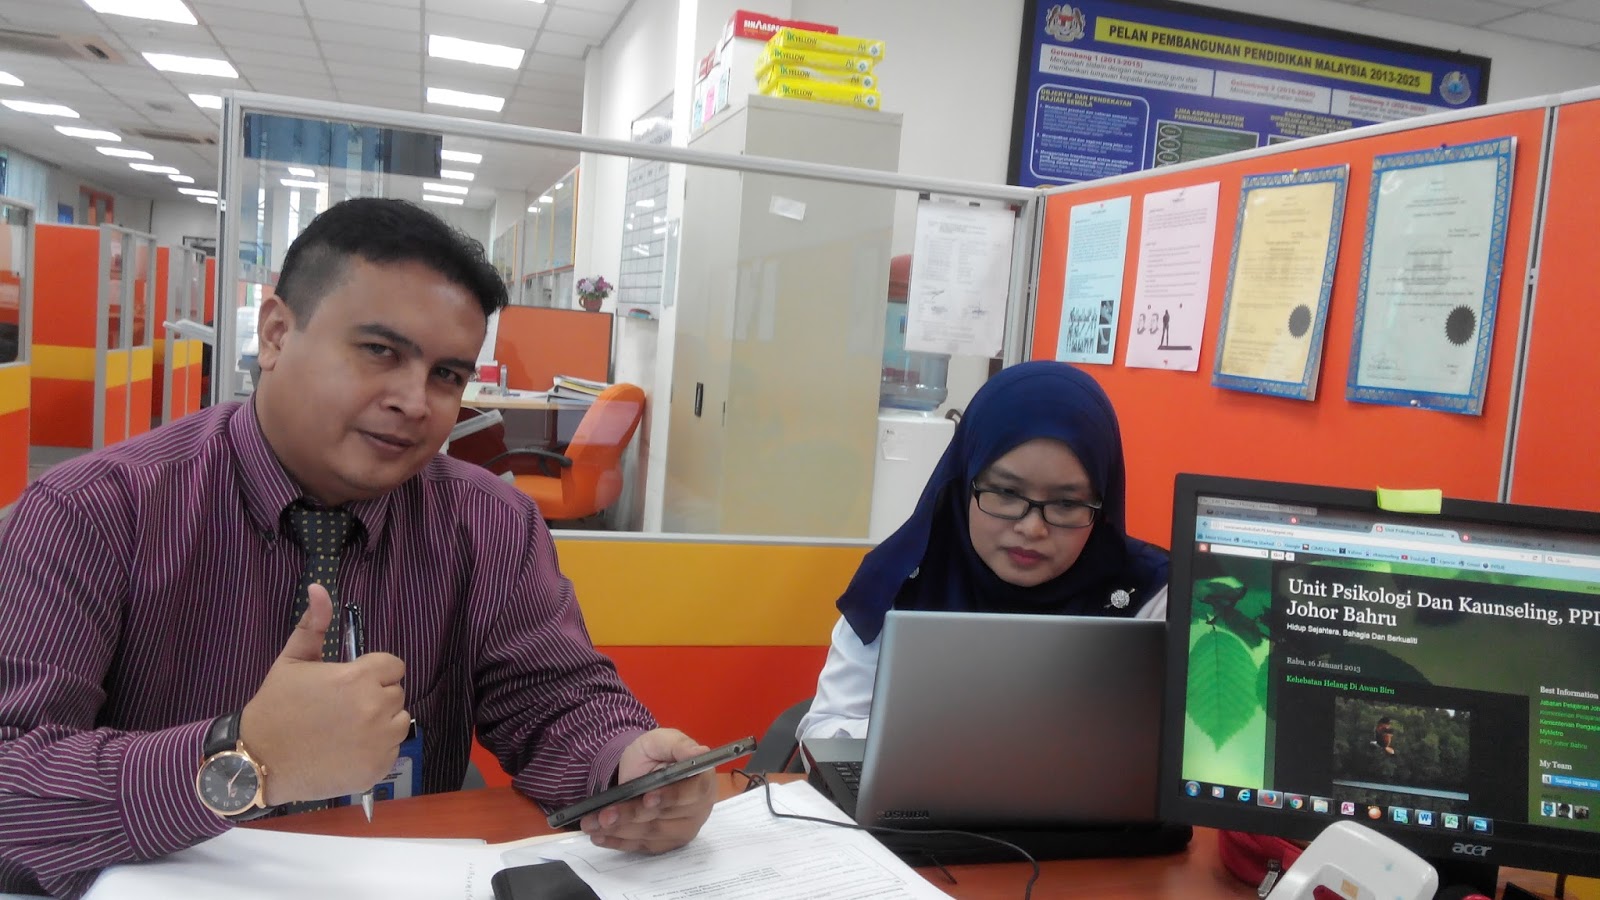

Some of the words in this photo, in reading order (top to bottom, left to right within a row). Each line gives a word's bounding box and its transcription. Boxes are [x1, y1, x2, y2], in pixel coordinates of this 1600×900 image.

[796, 36, 817, 45] YELLOW
[784, 52, 805, 62] YELLOW
[1050, 48, 1092, 61] Gelombang
[1100, 56, 1143, 68] (2013-2015)
[1109, 24, 1148, 43] PELAN
[1152, 31, 1240, 56] PEMBANGUNAN
[1244, 48, 1312, 68] PENDIDIKAN
[1314, 59, 1367, 78] MALAYSIA
[1370, 68, 1420, 88] 2013-2025
[791, 89, 813, 97] YELLOW
[1288, 578, 1328, 597] Unit
[1332, 582, 1412, 609] Psikologi
[1417, 592, 1453, 611] Dan
[1458, 596, 1563, 626] Kaunseling,
[1286, 600, 1339, 620] Johor
[1343, 606, 1397, 626] Bahru
[1286, 623, 1306, 632] Hidup
[1308, 625, 1341, 636] Sejahtera,
[1343, 629, 1370, 640] Bahagia
[1372, 632, 1385, 640] Dan
[1387, 634, 1418, 644] Berkualiti
[1286, 656, 1306, 666] Rabu,
[1308, 659, 1316, 667] 16
[1317, 660, 1343, 670] Januari
[1344, 665, 1361, 673] 2013
[1286, 675, 1322, 686] Kehebatan
[1324, 679, 1348, 690] Helang
[1350, 682, 1358, 690] Di
[1360, 684, 1379, 693] Awan
[1380, 686, 1395, 695] Biru
[1540, 686, 1555, 695] Best
[1557, 688, 1599, 699] Information
[1540, 760, 1551, 769] My
[1552, 761, 1572, 770] Team
[1452, 842, 1492, 857] acer
